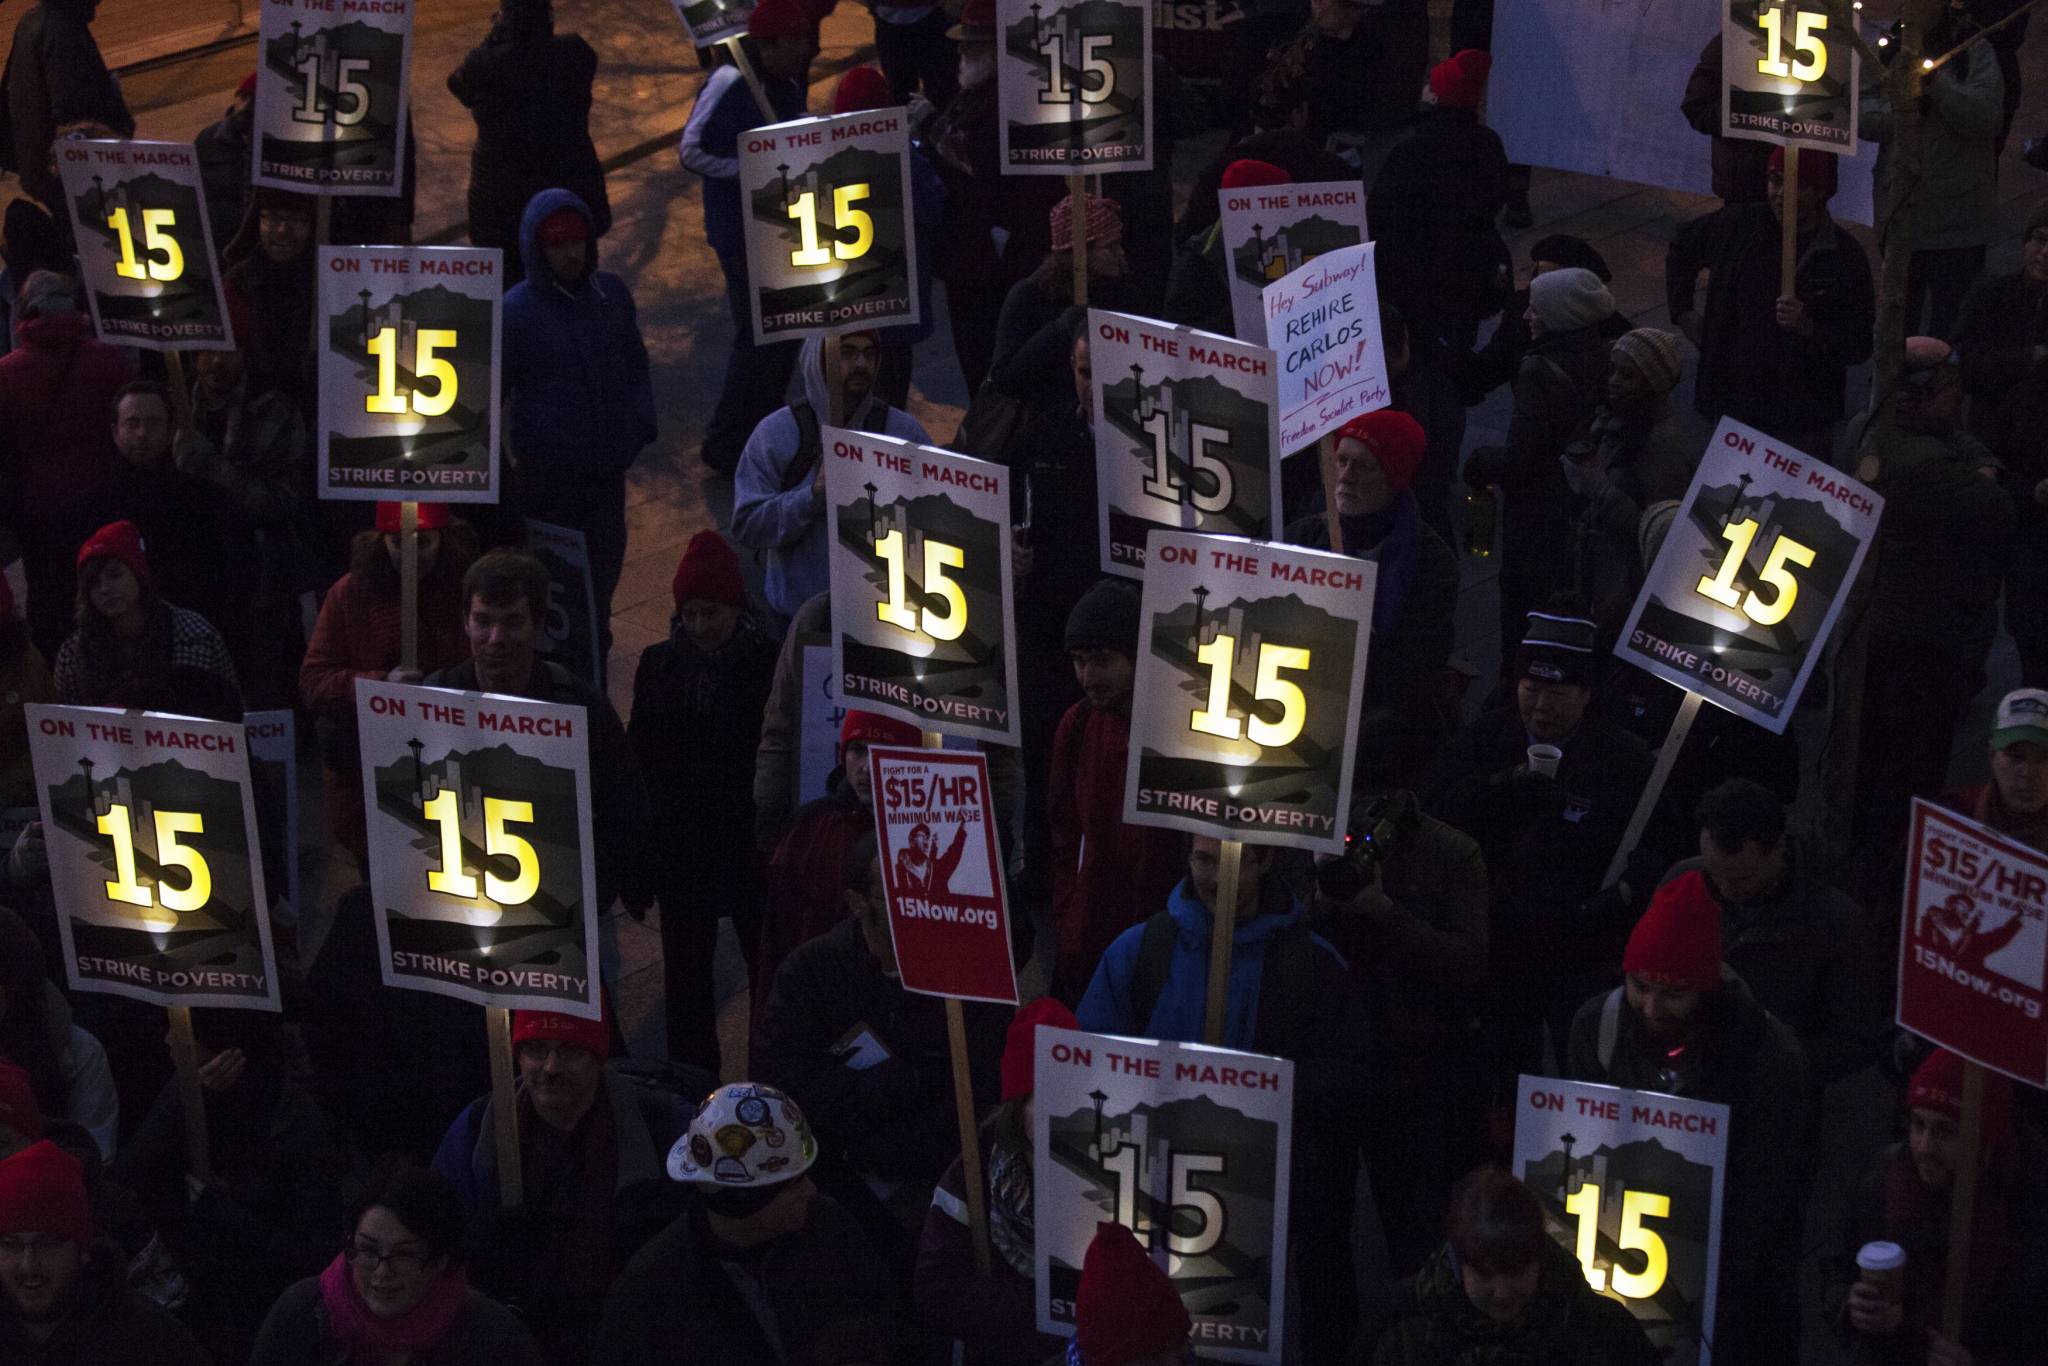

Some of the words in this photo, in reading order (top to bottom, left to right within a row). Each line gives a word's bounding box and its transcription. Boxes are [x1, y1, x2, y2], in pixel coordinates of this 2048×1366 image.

[343, 0, 405, 14] MARCH
[1038, 34, 1117, 104] 15
[1757, 7, 1828, 83] 15
[292, 53, 371, 126] 15
[747, 138, 780, 154] ON
[788, 130, 822, 147] THE
[831, 118, 898, 141] MARCH
[1730, 111, 1780, 131] STRIKE
[1782, 120, 1850, 141] POVERTY
[65, 150, 89, 164] ON
[95, 150, 127, 165] THE
[132, 152, 191, 167] MARCH
[262, 161, 314, 181] STRIKE
[318, 167, 395, 184] POVERTY
[1010, 147, 1065, 161] STRIKE
[1071, 144, 1144, 161] POVERTY
[787, 182, 875, 267] 15
[1228, 197, 1251, 211] ON
[1257, 195, 1289, 209] THE
[1297, 191, 1356, 207] MARCH
[107, 207, 185, 283] 15
[330, 258, 360, 273] ON
[370, 258, 410, 274] THE
[420, 260, 493, 276] MARCH
[1271, 291, 1294, 319] Hey
[1302, 253, 1366, 299] Subway!
[102, 319, 150, 337] STRIKE
[152, 322, 224, 338] POVERTY
[763, 310, 824, 329] STRIKE
[830, 298, 908, 322] POVERTY
[1286, 293, 1354, 344] REHIRE
[1100, 324, 1130, 345] ON
[1140, 334, 1178, 357] THE
[1189, 347, 1267, 376] MARCH
[1286, 319, 1363, 373] CARLOS
[1304, 339, 1366, 400] NOW!
[365, 327, 459, 417] 15
[330, 466, 395, 484] STRIKE
[401, 470, 489, 485] POVERTY
[833, 442, 863, 463] ON
[873, 451, 913, 475] THE
[922, 463, 999, 494] MARCH
[1142, 409, 1235, 515] 15
[1724, 430, 1755, 456] ON
[1763, 448, 1802, 478] THE
[1807, 470, 1875, 517] MARCH
[1110, 541, 1145, 563] STR
[1160, 545, 1197, 565] ON
[1211, 552, 1258, 575] THE
[1271, 562, 1362, 591] MARCH
[1695, 517, 1817, 626] 15
[874, 529, 969, 641] 15
[1189, 633, 1312, 748] 15
[1631, 628, 1699, 670] STRIKE
[1699, 660, 1784, 712] POVERTY
[369, 695, 406, 718] ON
[417, 701, 467, 727] THE
[477, 711, 573, 738] MARCH
[844, 673, 909, 704] STRIKE
[913, 692, 1008, 724] POVERTY
[39, 718, 76, 738] ON
[85, 722, 134, 746] THE
[145, 729, 235, 754] MARCH
[883, 767, 905, 775] FIGHT
[907, 766, 921, 774] FOR
[924, 765, 929, 774] A
[885, 774, 978, 812] $15/HR
[888, 811, 942, 825] MINIMUM
[1138, 787, 1218, 817] STRIKE
[1225, 804, 1335, 831] POVERTY
[96, 802, 213, 912] 15
[423, 787, 541, 907] 15
[1925, 837, 2047, 906] $15/HR
[896, 896, 998, 930] 15Now.org
[77, 955, 152, 985] STRIKE
[157, 969, 266, 991] POVERTY
[392, 950, 472, 981] STRIKE
[476, 967, 589, 996] POVERTY
[1914, 942, 2043, 1019] 15Now.org
[1051, 1043, 1092, 1067] ON
[1107, 1053, 1161, 1079] THE
[1175, 1062, 1279, 1092] MARCH
[1530, 1090, 1565, 1112] ON
[1576, 1097, 1620, 1122] THE
[1631, 1106, 1716, 1136] MARCH
[1100, 1142, 1227, 1256] 15
[1566, 1182, 1672, 1299] 15
